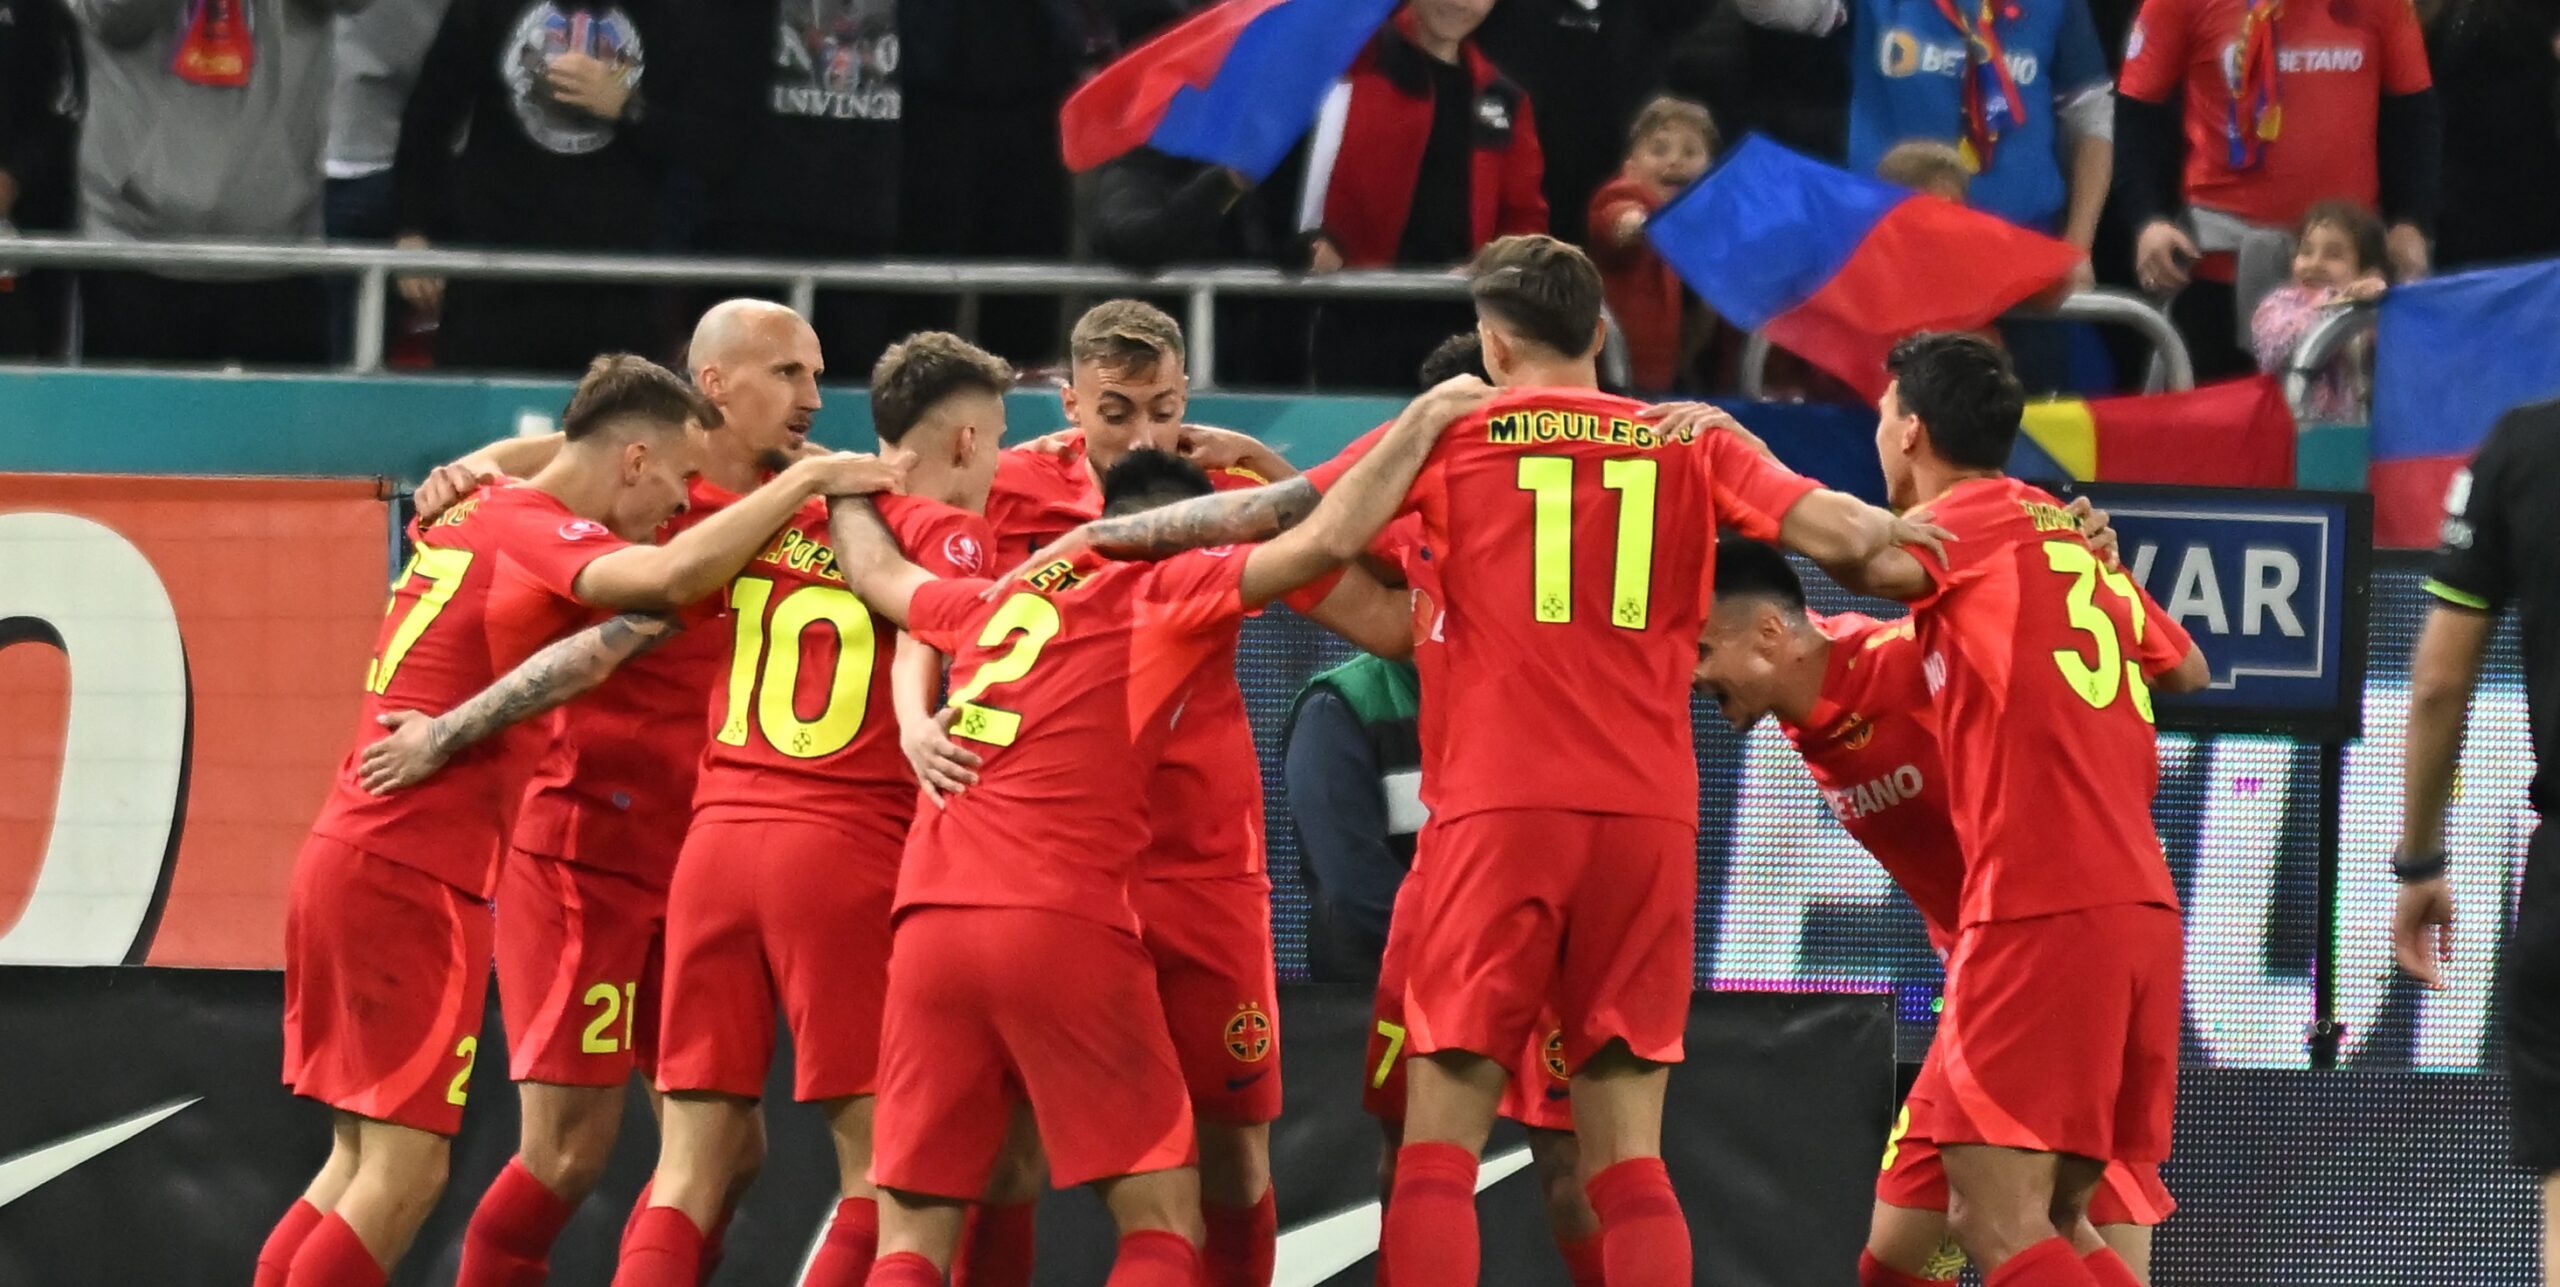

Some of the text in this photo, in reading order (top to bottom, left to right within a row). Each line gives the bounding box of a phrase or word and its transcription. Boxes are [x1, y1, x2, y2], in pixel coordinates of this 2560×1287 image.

[1488, 409, 1696, 449] MICULESU
[1517, 456, 1658, 630] 11
[716, 576, 876, 758] 10
[947, 591, 1060, 747] 2
[581, 981, 637, 1055] 21
